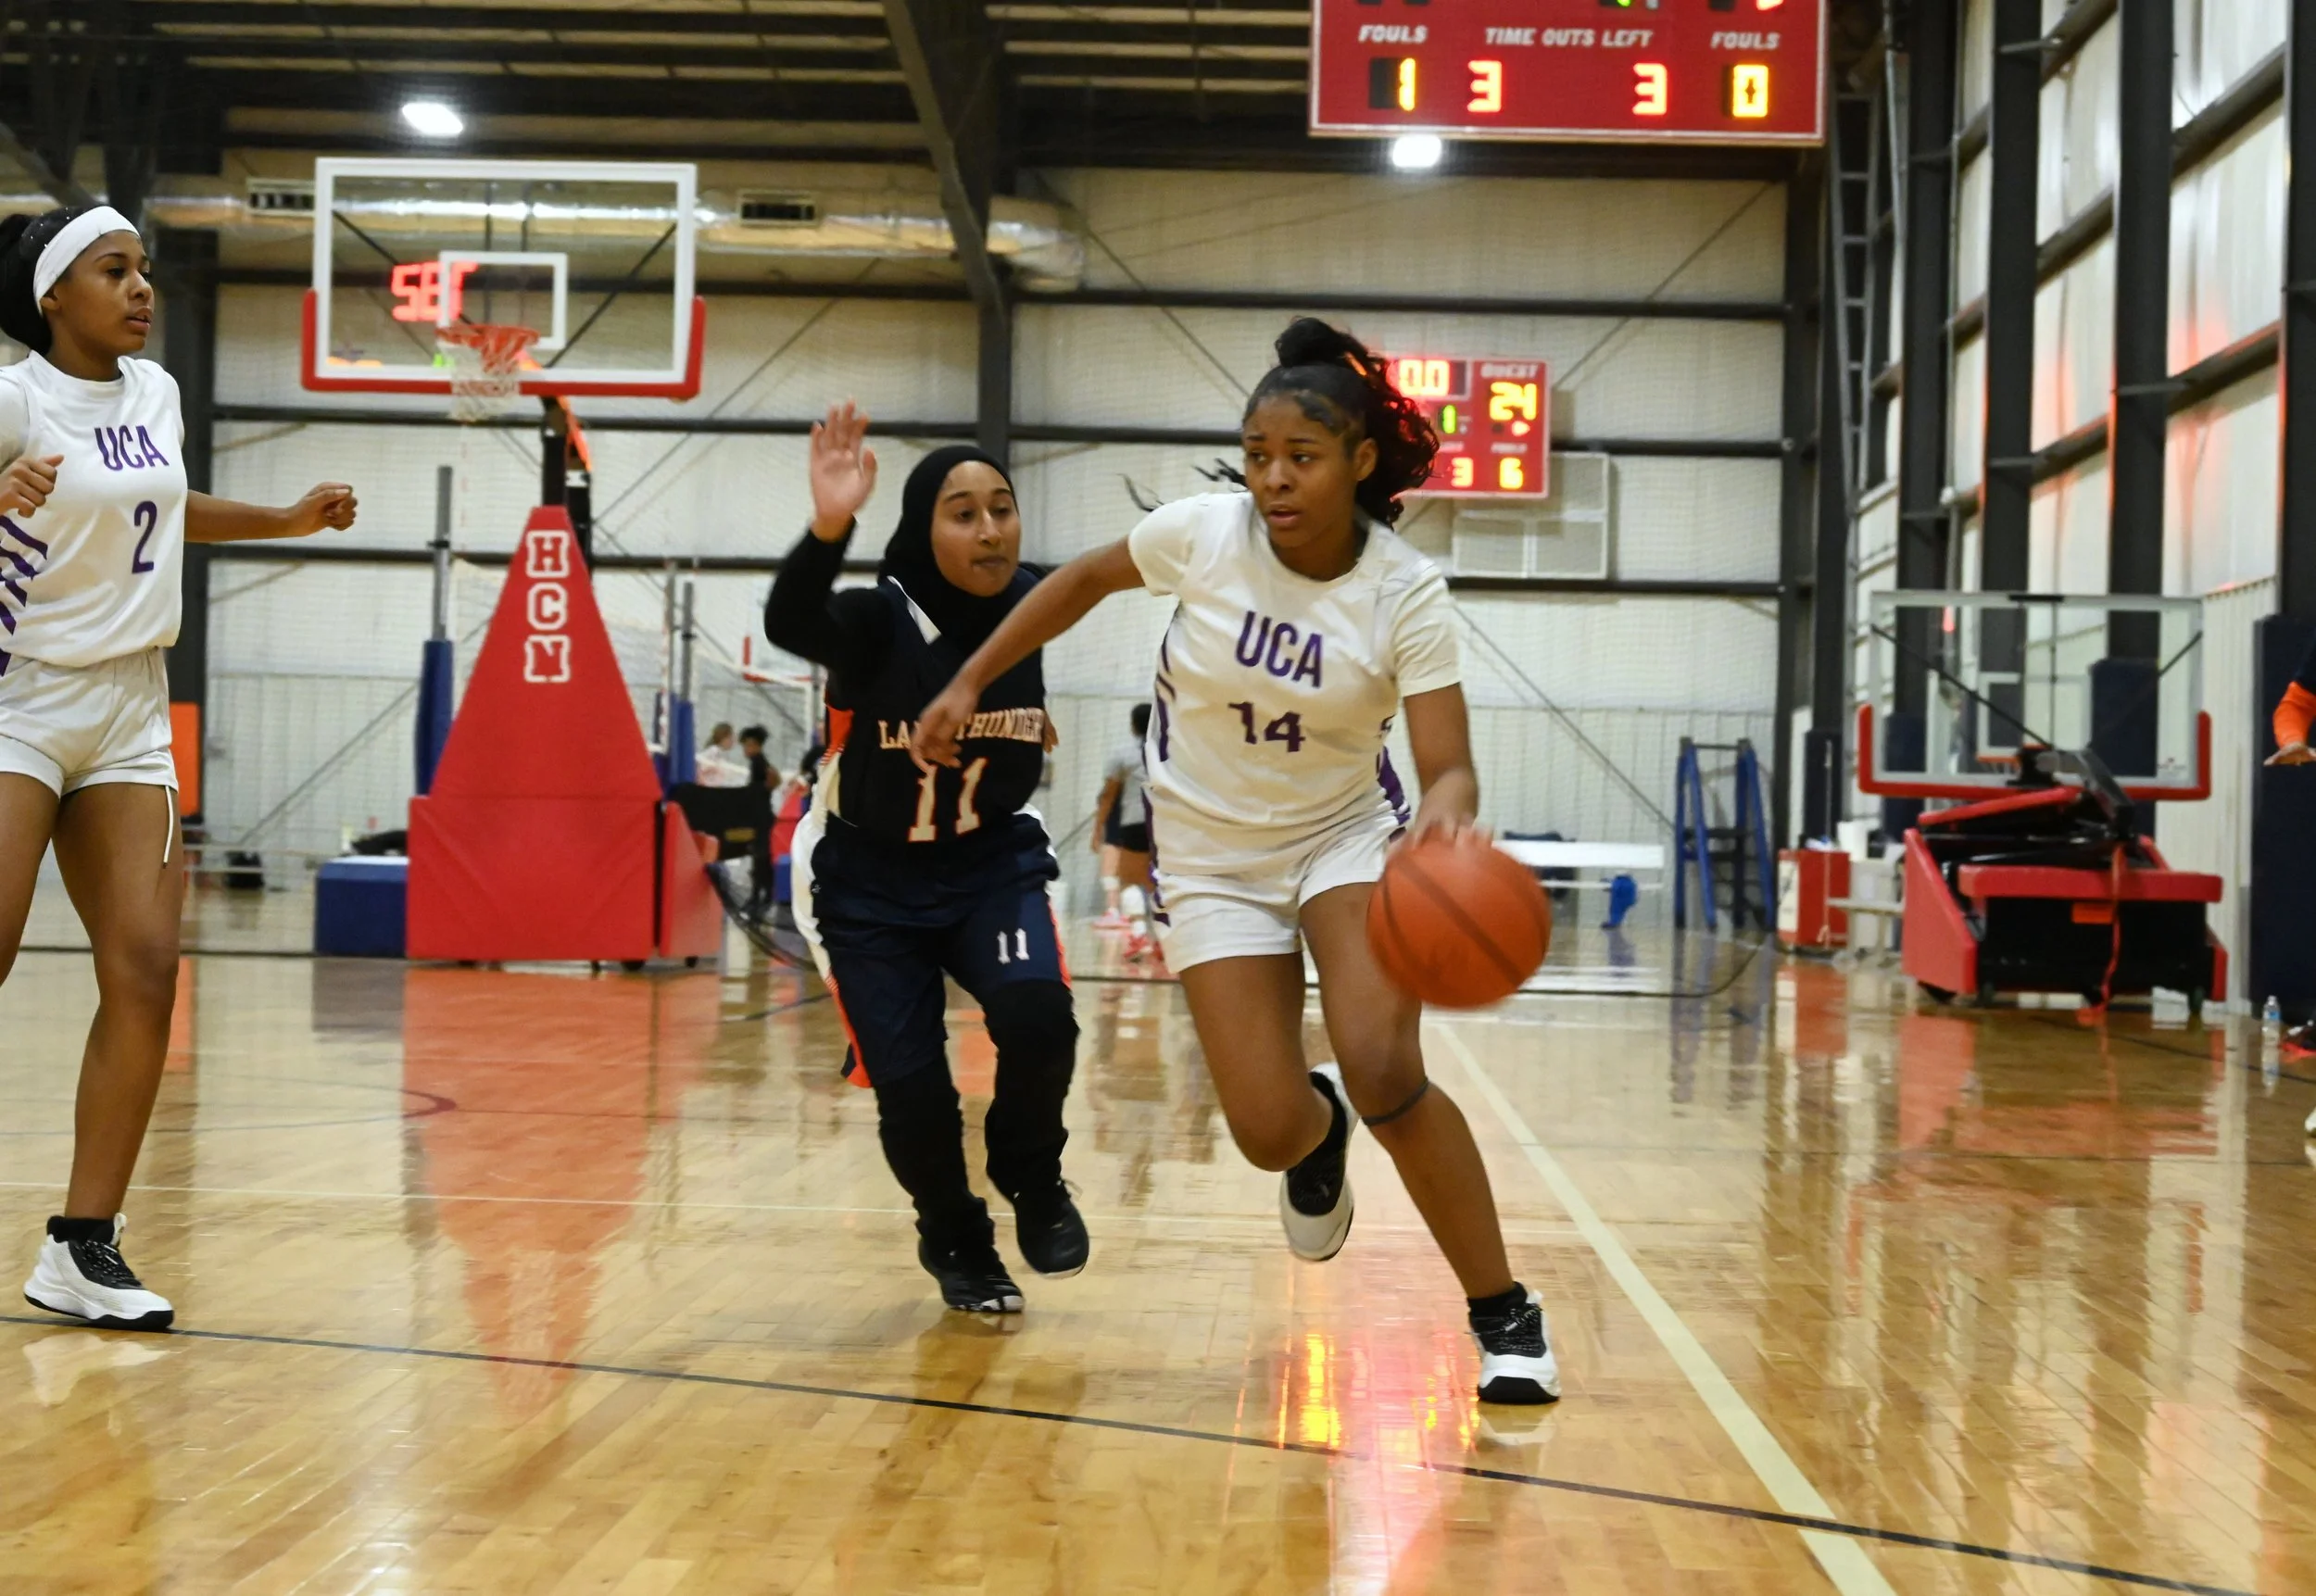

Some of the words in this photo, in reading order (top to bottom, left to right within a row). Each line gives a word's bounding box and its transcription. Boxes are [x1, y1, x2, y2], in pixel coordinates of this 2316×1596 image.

[1359, 25, 1428, 44] FOULS
[1485, 28, 1535, 45] TIME
[1542, 29, 1594, 46] OUTS
[1602, 30, 1654, 47] LEFT
[1710, 31, 1780, 49] FOULS
[1399, 57, 1416, 111] 1
[1467, 60, 1502, 113] 3
[1632, 63, 1668, 116] 3
[1732, 64, 1768, 118] 0
[1442, 404, 1456, 434] 1
[1489, 381, 1537, 421] 24
[94, 424, 170, 471] UCA
[1451, 457, 1474, 487] 3
[1499, 457, 1524, 489] 6
[132, 500, 157, 574] 2
[1235, 610, 1323, 688] UCA
[1227, 701, 1307, 753] 14
[907, 756, 988, 842] 11
[997, 928, 1030, 964] 11
